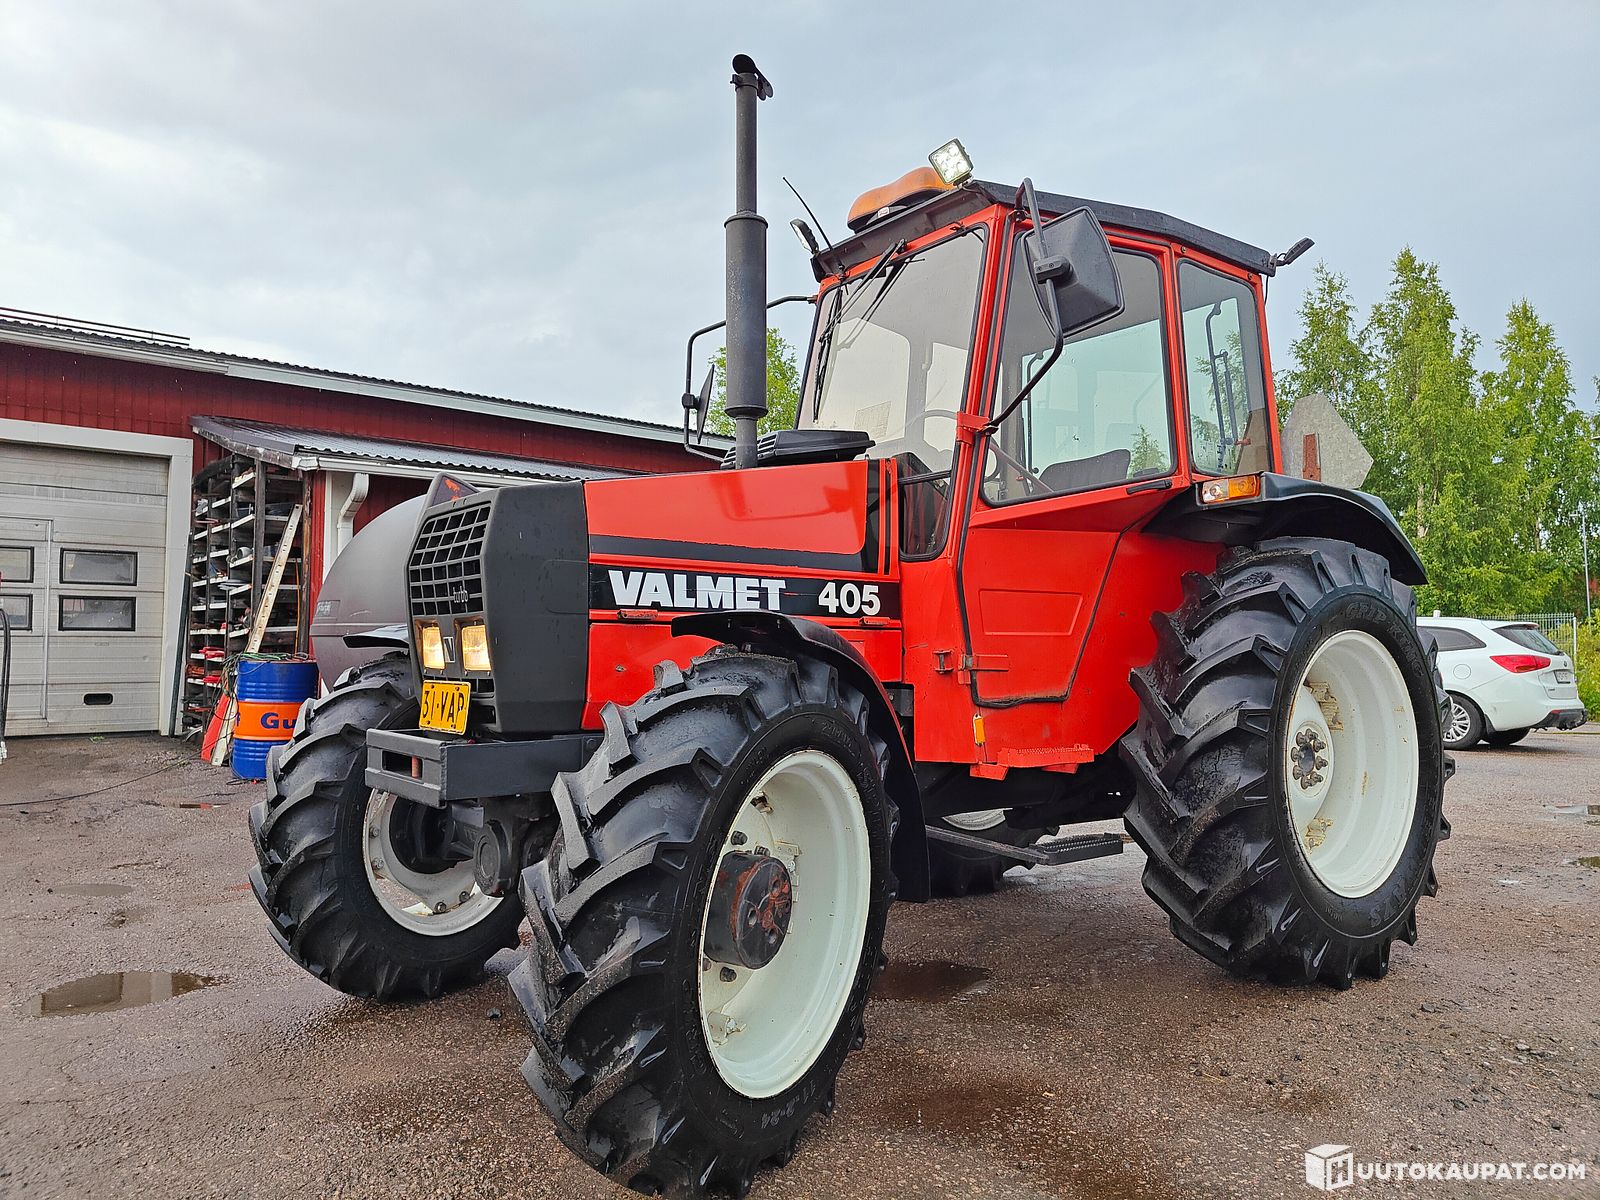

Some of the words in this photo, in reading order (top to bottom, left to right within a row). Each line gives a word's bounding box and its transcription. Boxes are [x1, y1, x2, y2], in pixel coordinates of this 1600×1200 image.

[608, 570, 786, 611] VALMET
[818, 581, 881, 616] 405
[260, 712, 297, 729] Gu
[422, 690, 465, 723] 31-VAP
